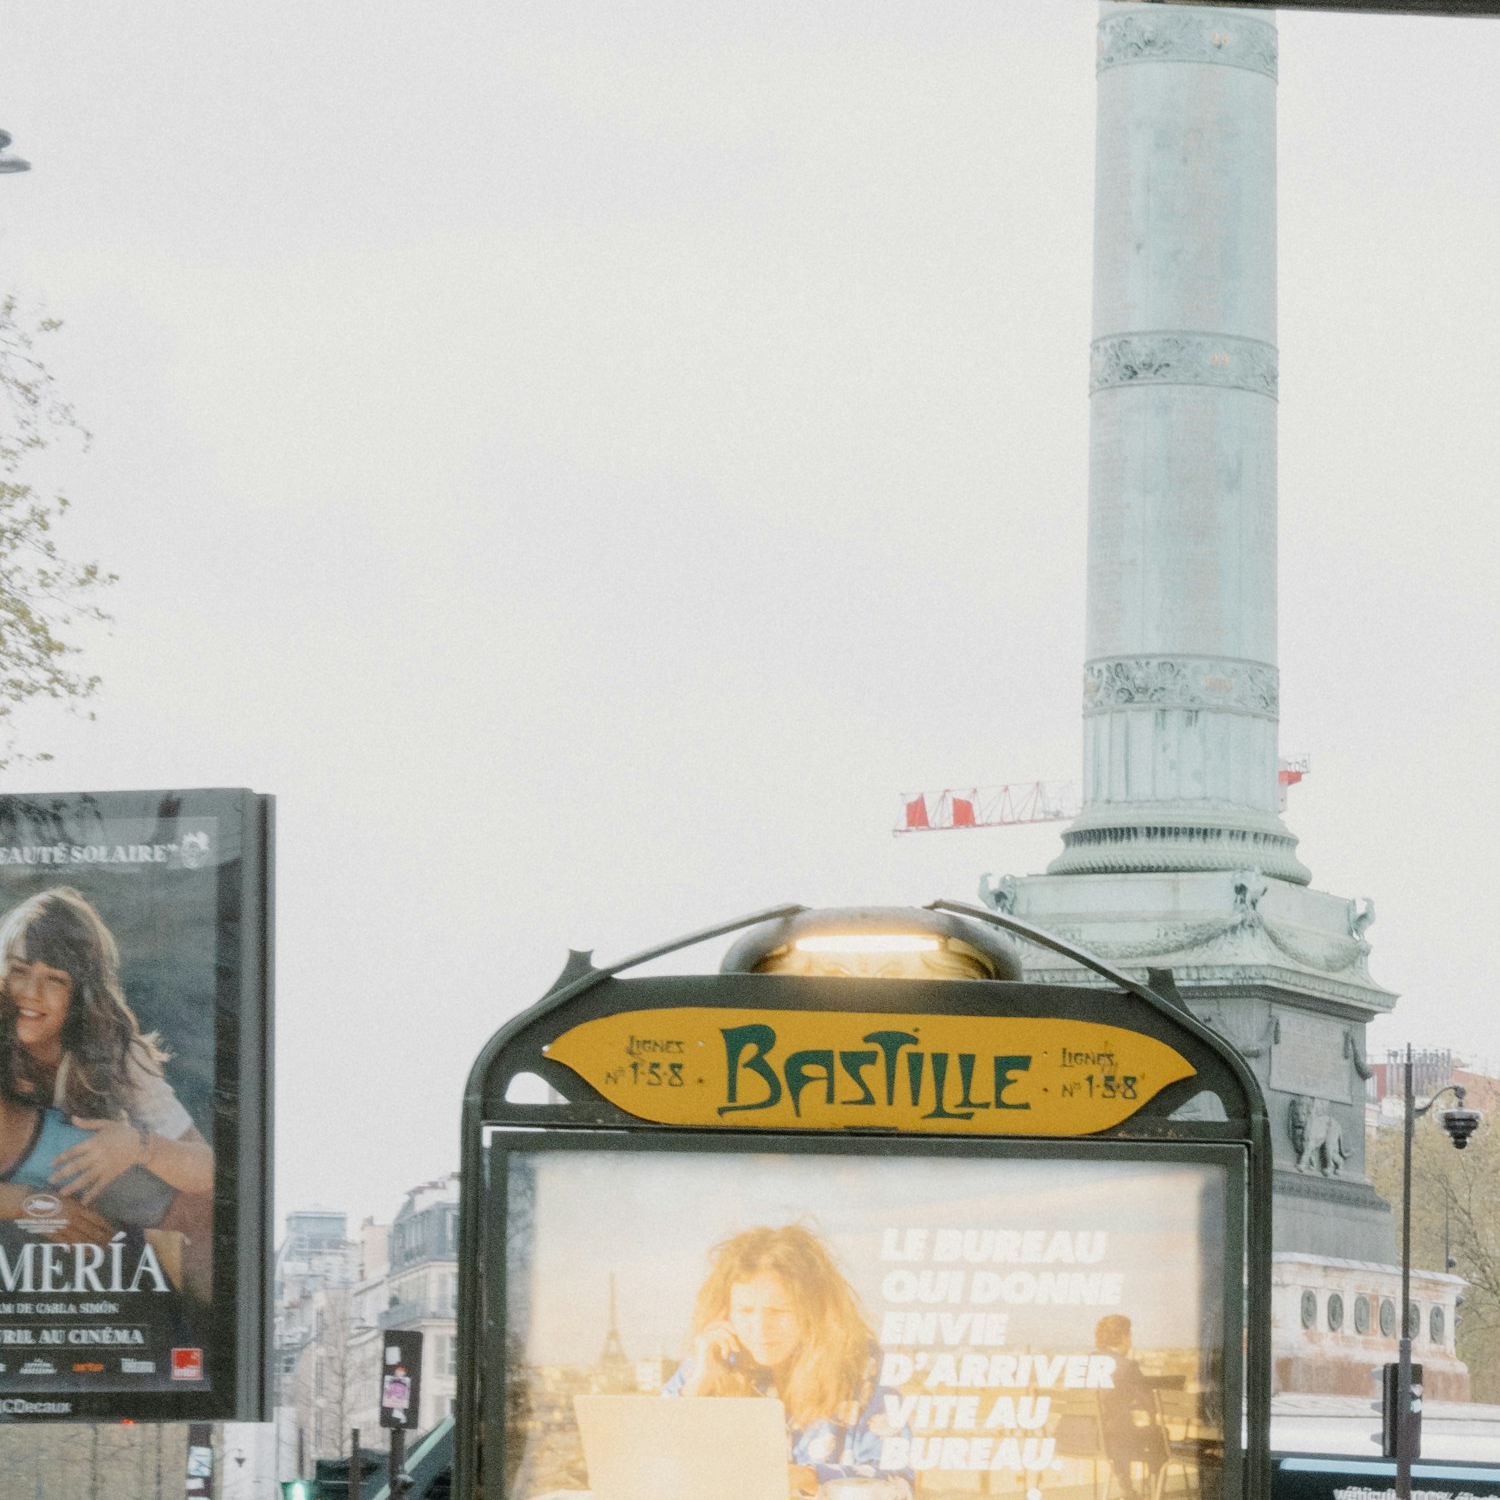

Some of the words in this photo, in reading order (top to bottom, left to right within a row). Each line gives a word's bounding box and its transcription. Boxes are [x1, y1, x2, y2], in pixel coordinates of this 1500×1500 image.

[716, 1023, 1032, 1120] BASTILLE
[879, 1228, 929, 1262] LE
[931, 1228, 1108, 1264] BUREAU
[968, 1271, 1124, 1305] DONNE
[38, 1329, 67, 1344] AU
[68, 1326, 145, 1345] CINÉMA
[880, 1311, 1009, 1346] ENVIE
[884, 1394, 980, 1429] VITE
[982, 1395, 1052, 1430] AU
[879, 1436, 1064, 1471] BUREAU.
